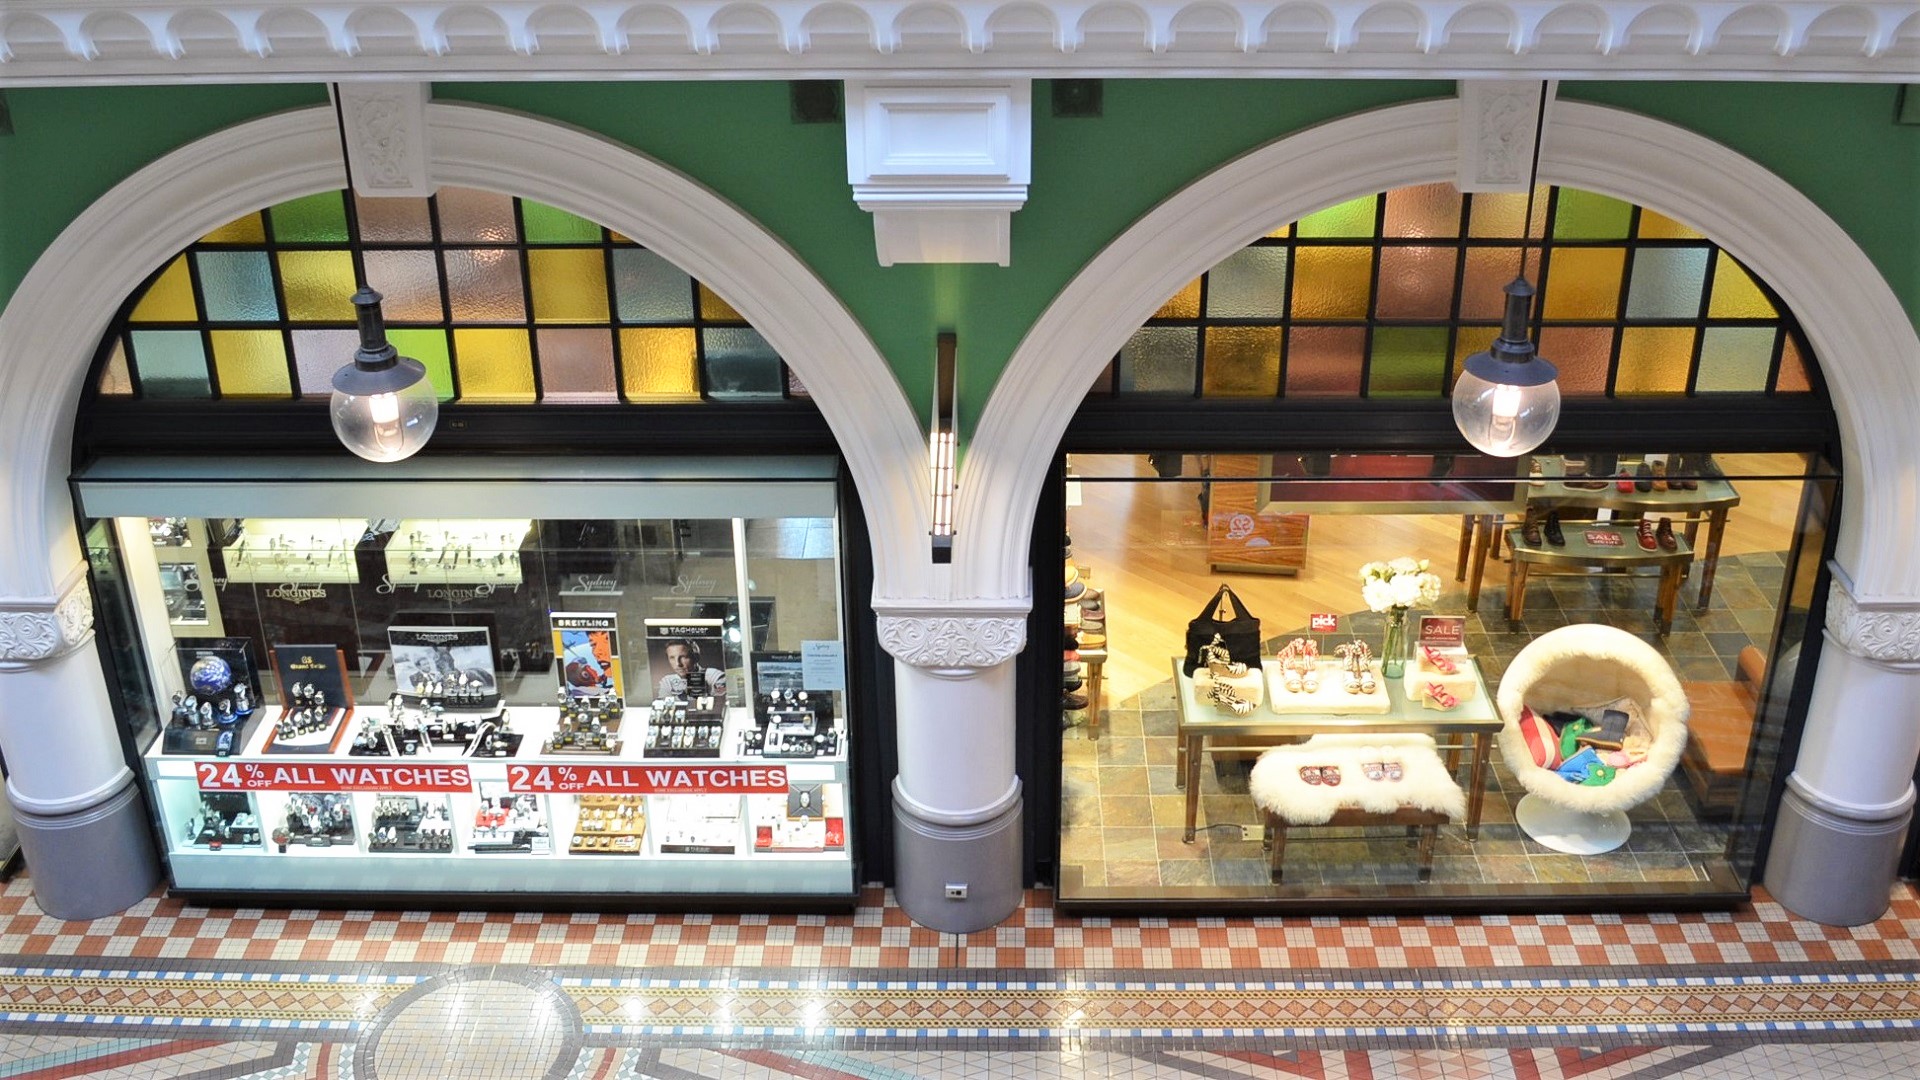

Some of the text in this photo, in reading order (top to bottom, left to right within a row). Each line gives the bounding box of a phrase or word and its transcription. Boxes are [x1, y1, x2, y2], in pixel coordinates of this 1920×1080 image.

[1587, 533, 1620, 541] SALE
[266, 588, 326, 599] LONGINES
[558, 619, 609, 627] BREITLING
[1312, 614, 1336, 628] pick
[1425, 624, 1460, 635] SALE
[416, 633, 459, 641] LONGINES
[246, 779, 272, 788] OFF
[273, 768, 325, 785] ALL
[330, 767, 470, 787] WATCHES
[558, 782, 585, 791] OFF
[586, 769, 639, 787] ALL
[645, 769, 786, 789] WATCHES
